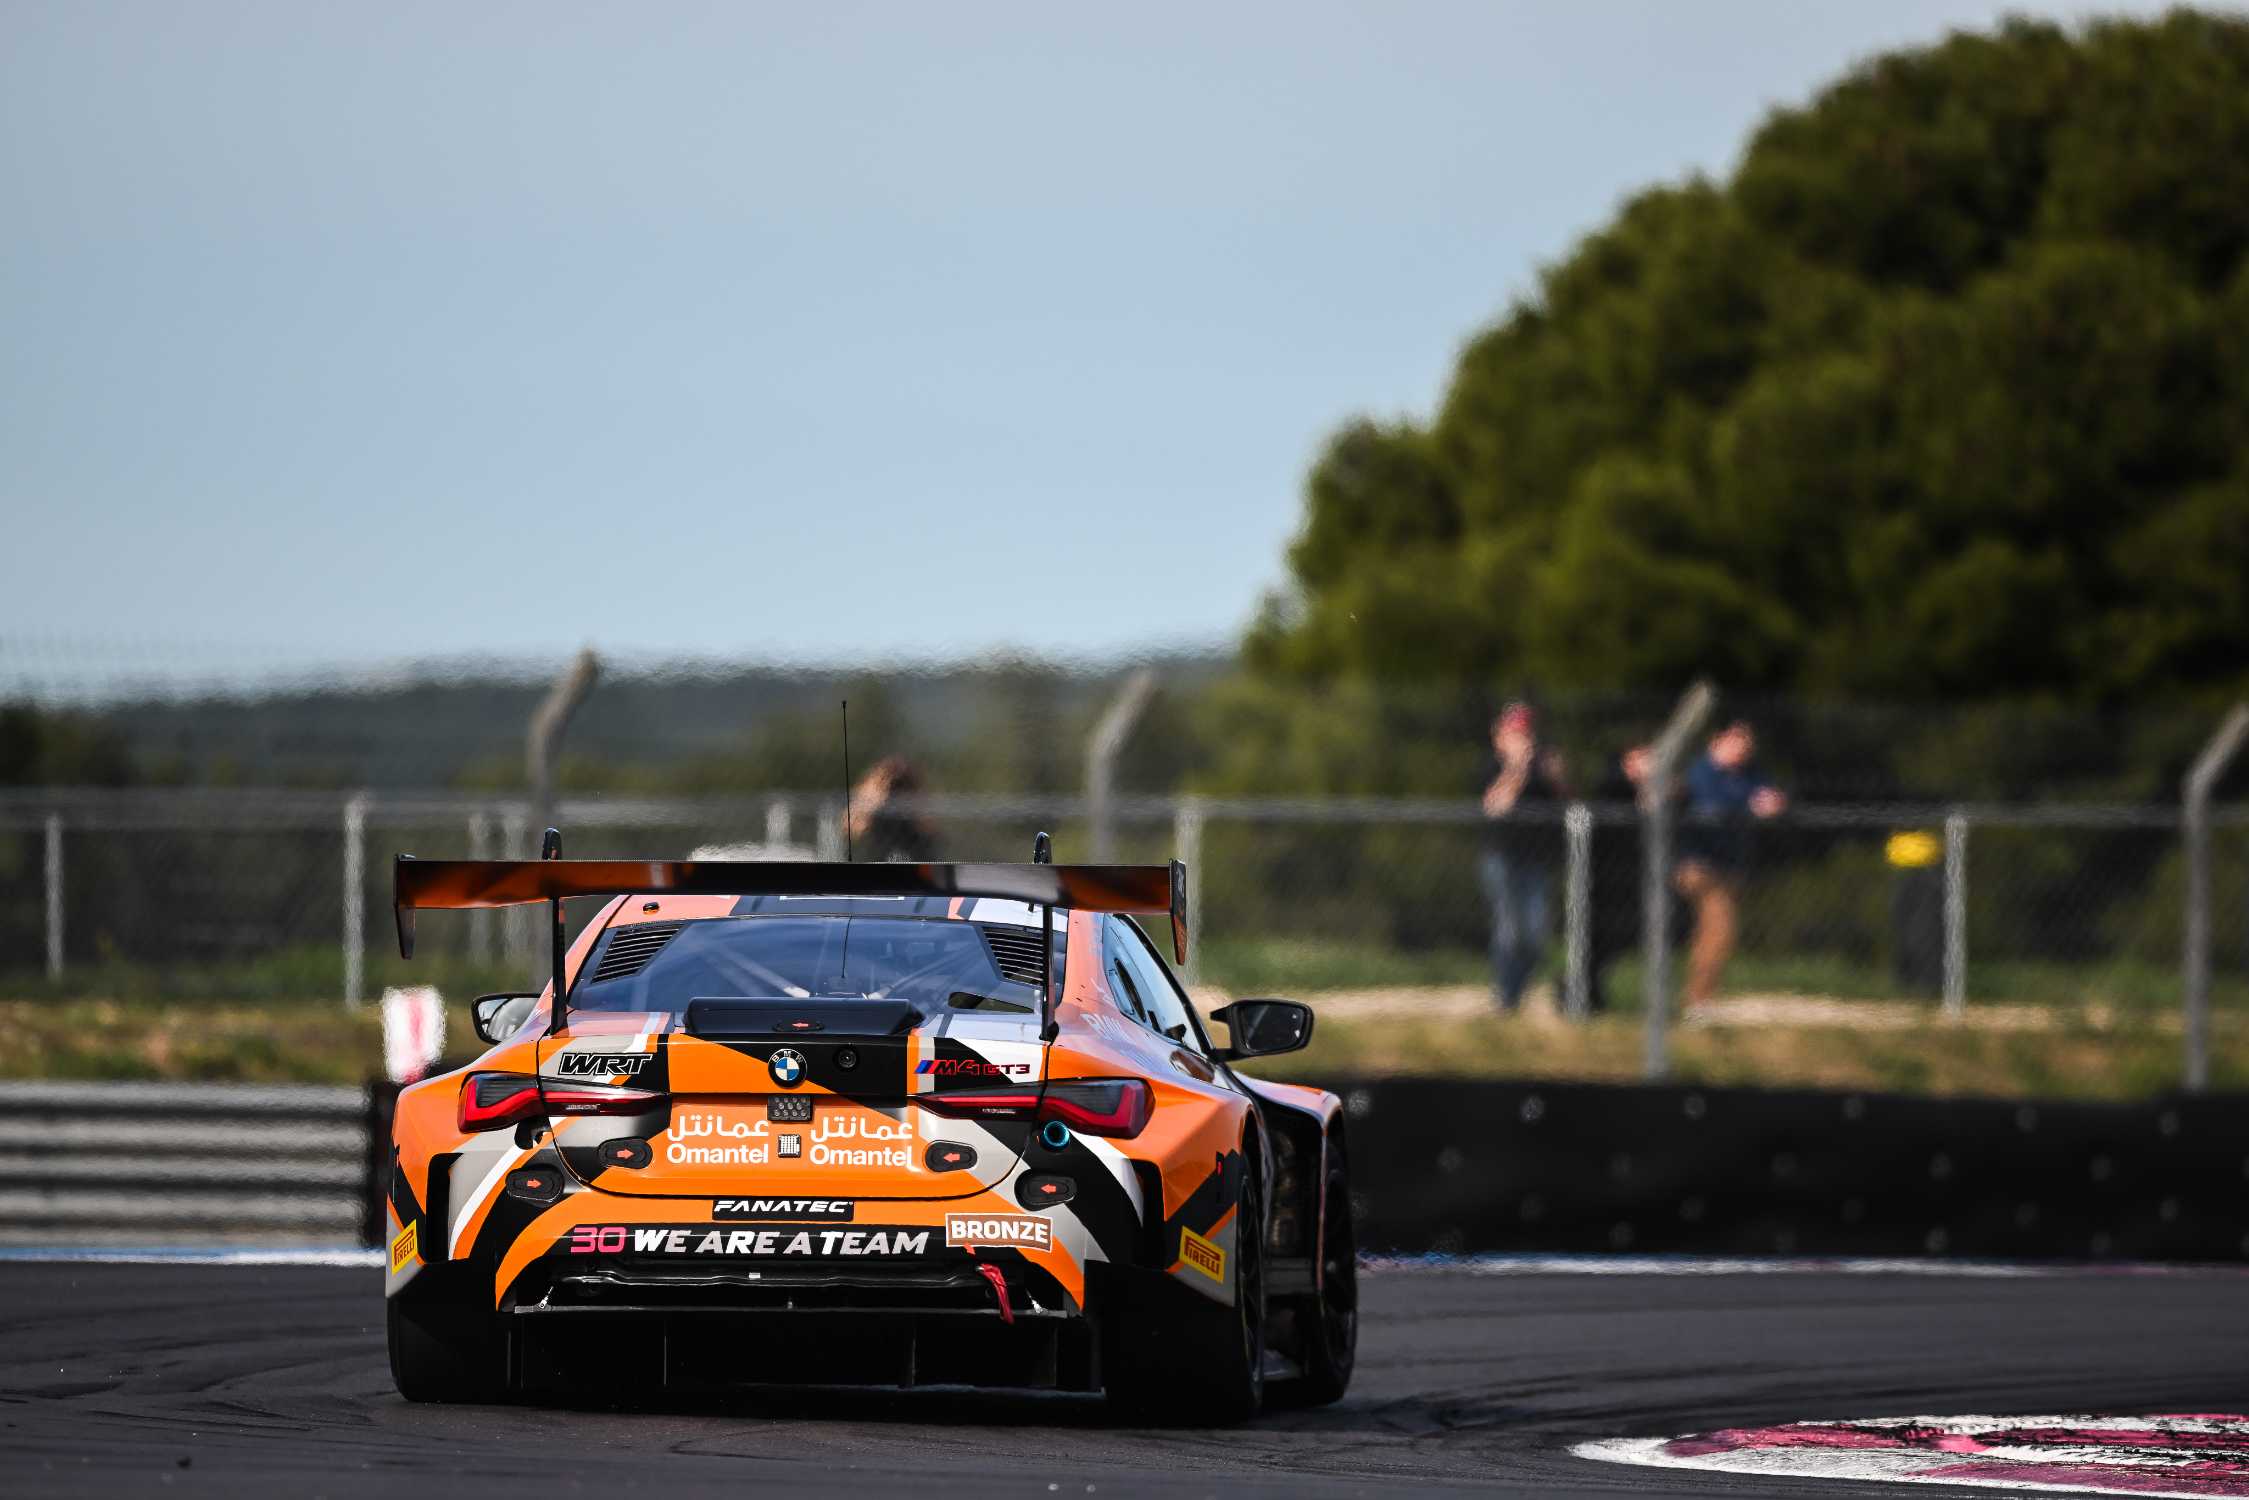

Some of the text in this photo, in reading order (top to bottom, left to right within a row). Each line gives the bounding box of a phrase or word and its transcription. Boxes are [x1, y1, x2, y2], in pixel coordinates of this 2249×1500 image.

[558, 1053, 653, 1075] WRT
[932, 1059, 1030, 1075] M4 GT3
[667, 1114, 768, 1141] عمانتل
[811, 1116, 912, 1143] عمانتل
[667, 1143, 768, 1163] Omantel
[810, 1144, 912, 1167] Omantel
[714, 1200, 853, 1213] FANATEC
[570, 1226, 627, 1253] 30
[634, 1230, 691, 1252] WE
[695, 1231, 780, 1254] ARE
[820, 1232, 929, 1254] TEAM
[951, 1220, 1048, 1243] BRONZE
[394, 1229, 415, 1267] PIRELLI
[1184, 1235, 1221, 1275] PIRELLI
